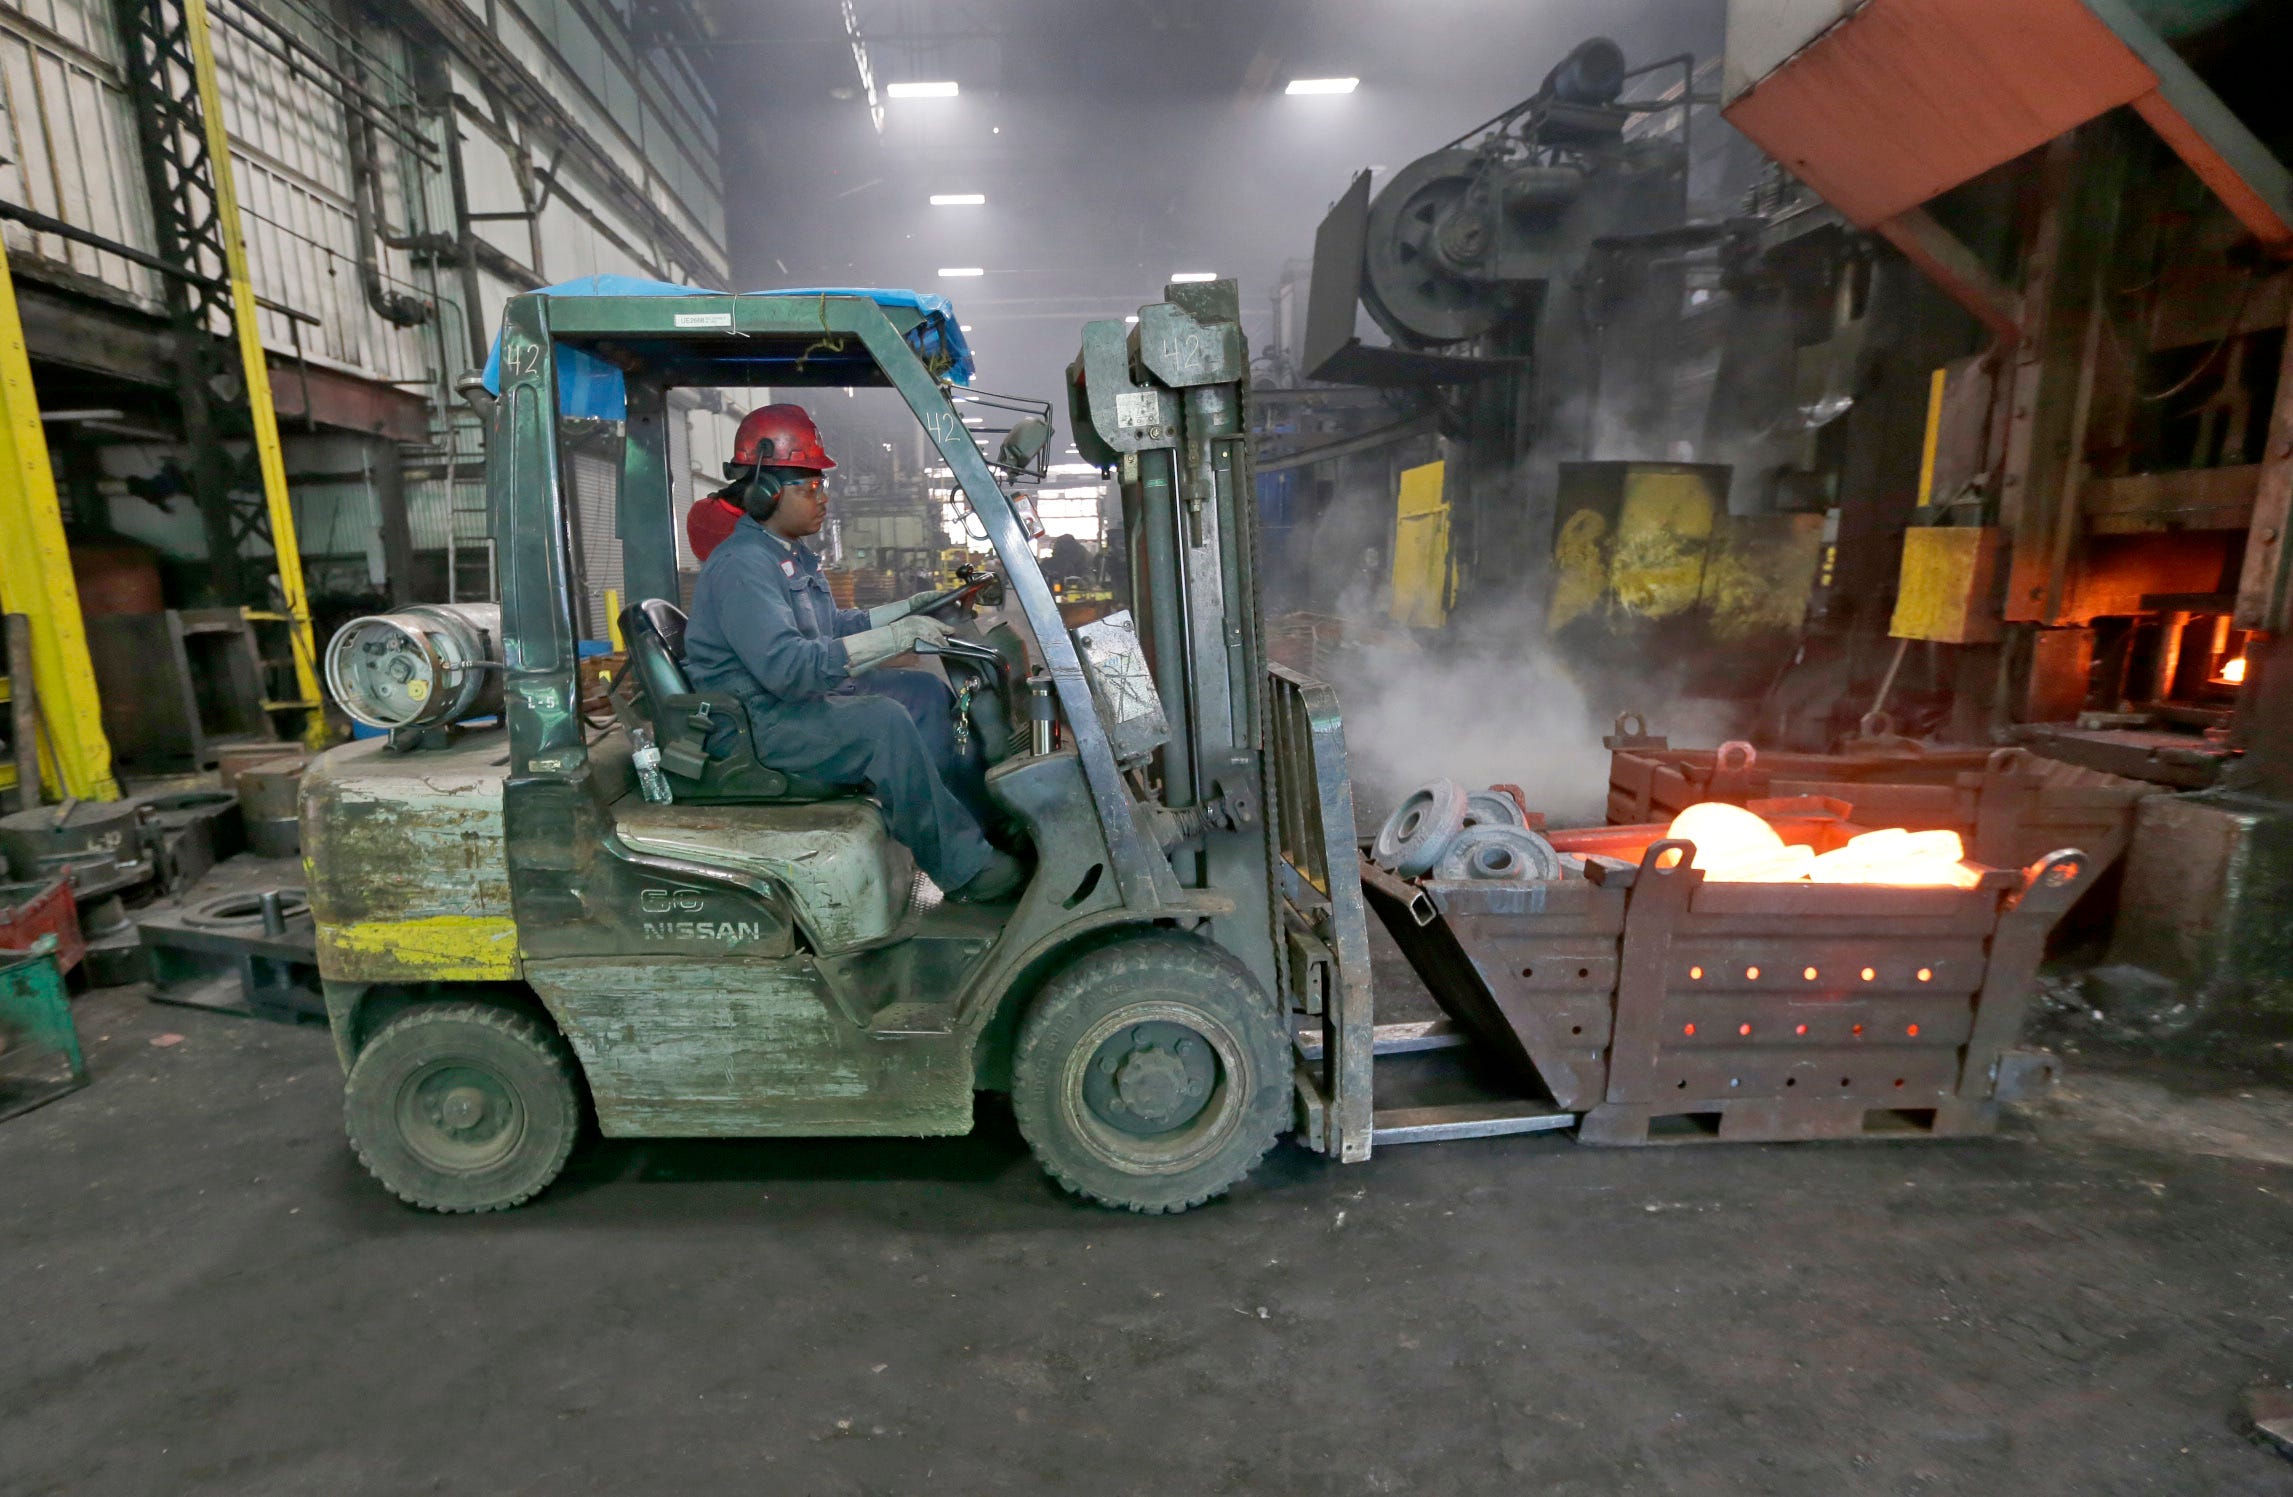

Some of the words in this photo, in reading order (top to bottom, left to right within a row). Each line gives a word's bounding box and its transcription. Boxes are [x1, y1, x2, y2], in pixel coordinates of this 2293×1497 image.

[507, 344, 540, 376] 42
[1163, 335, 1200, 371] 42
[926, 412, 961, 443] 42
[528, 695, 555, 709] L-5
[643, 922, 760, 940] NISSAN
